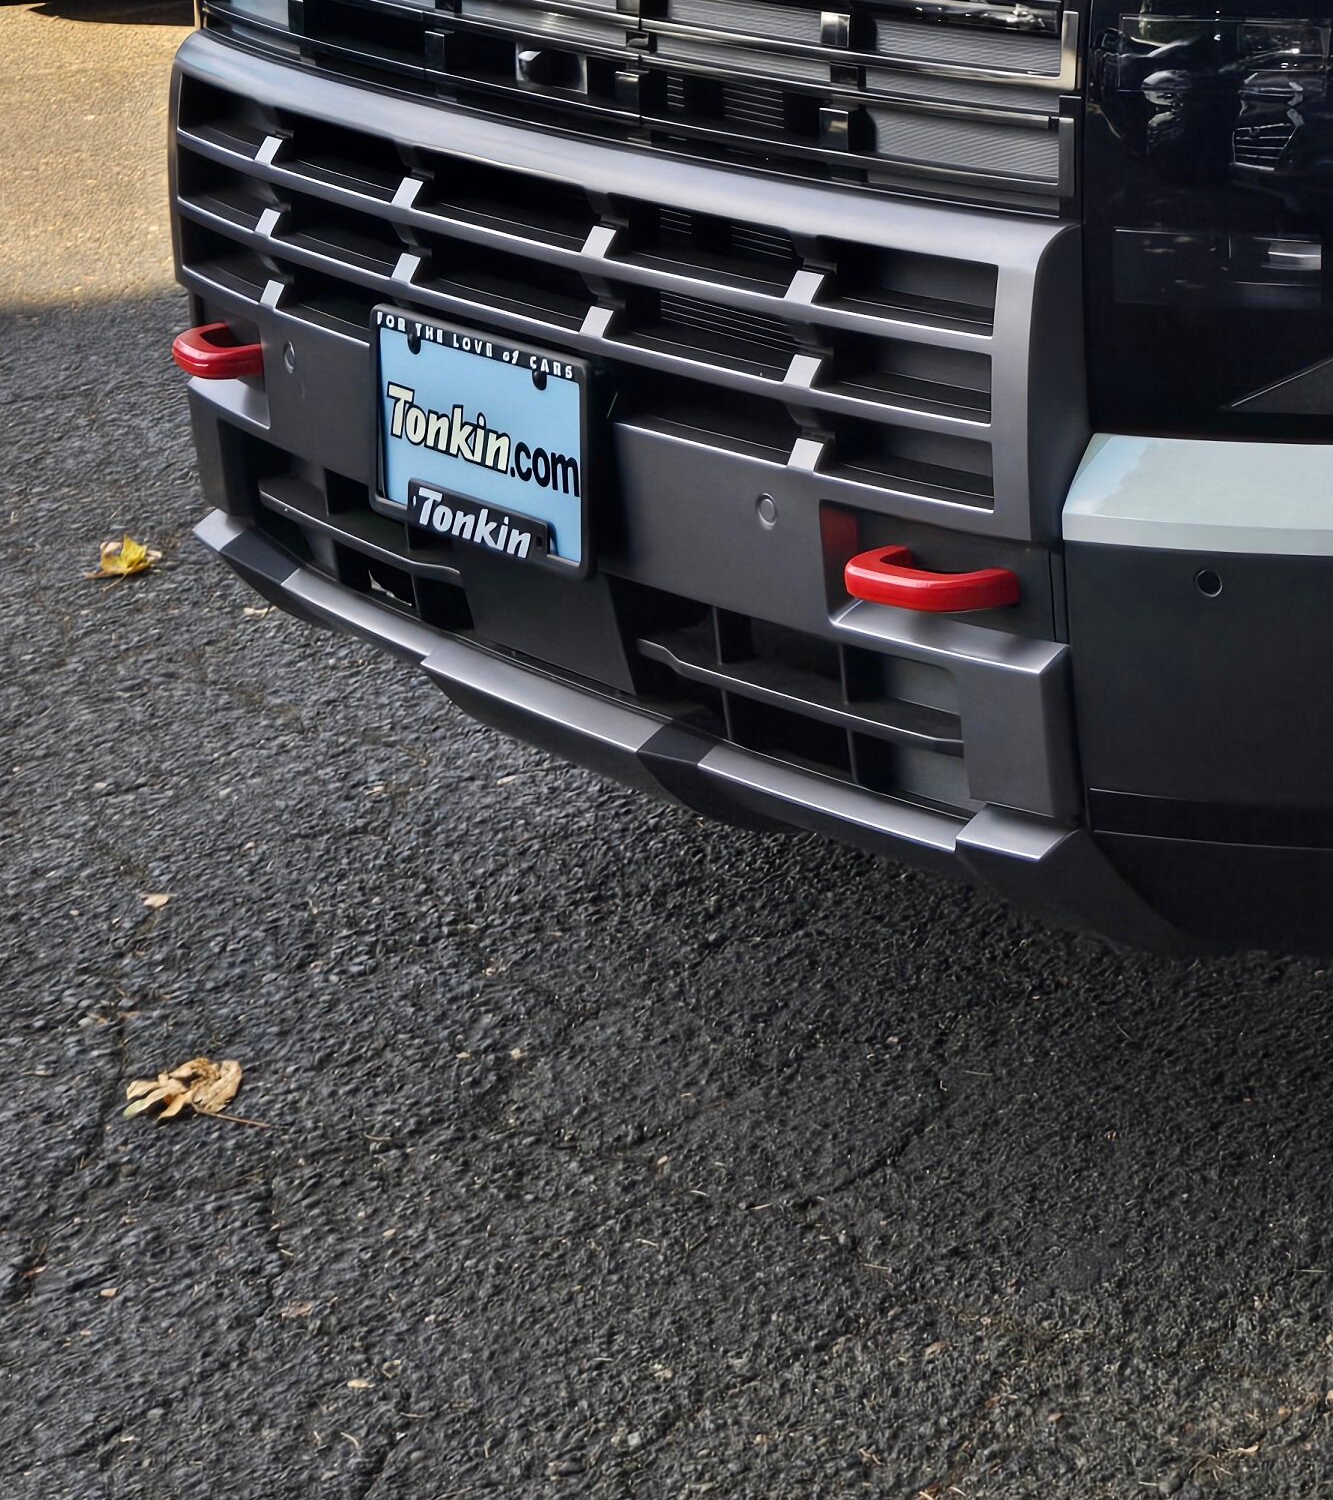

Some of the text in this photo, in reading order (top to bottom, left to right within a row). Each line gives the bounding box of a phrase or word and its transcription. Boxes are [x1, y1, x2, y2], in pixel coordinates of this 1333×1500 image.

[376, 311, 574, 379] FOR THE LOVE of CARS
[387, 381, 581, 498] Tonkin.com
[418, 487, 532, 559] Tonkin
